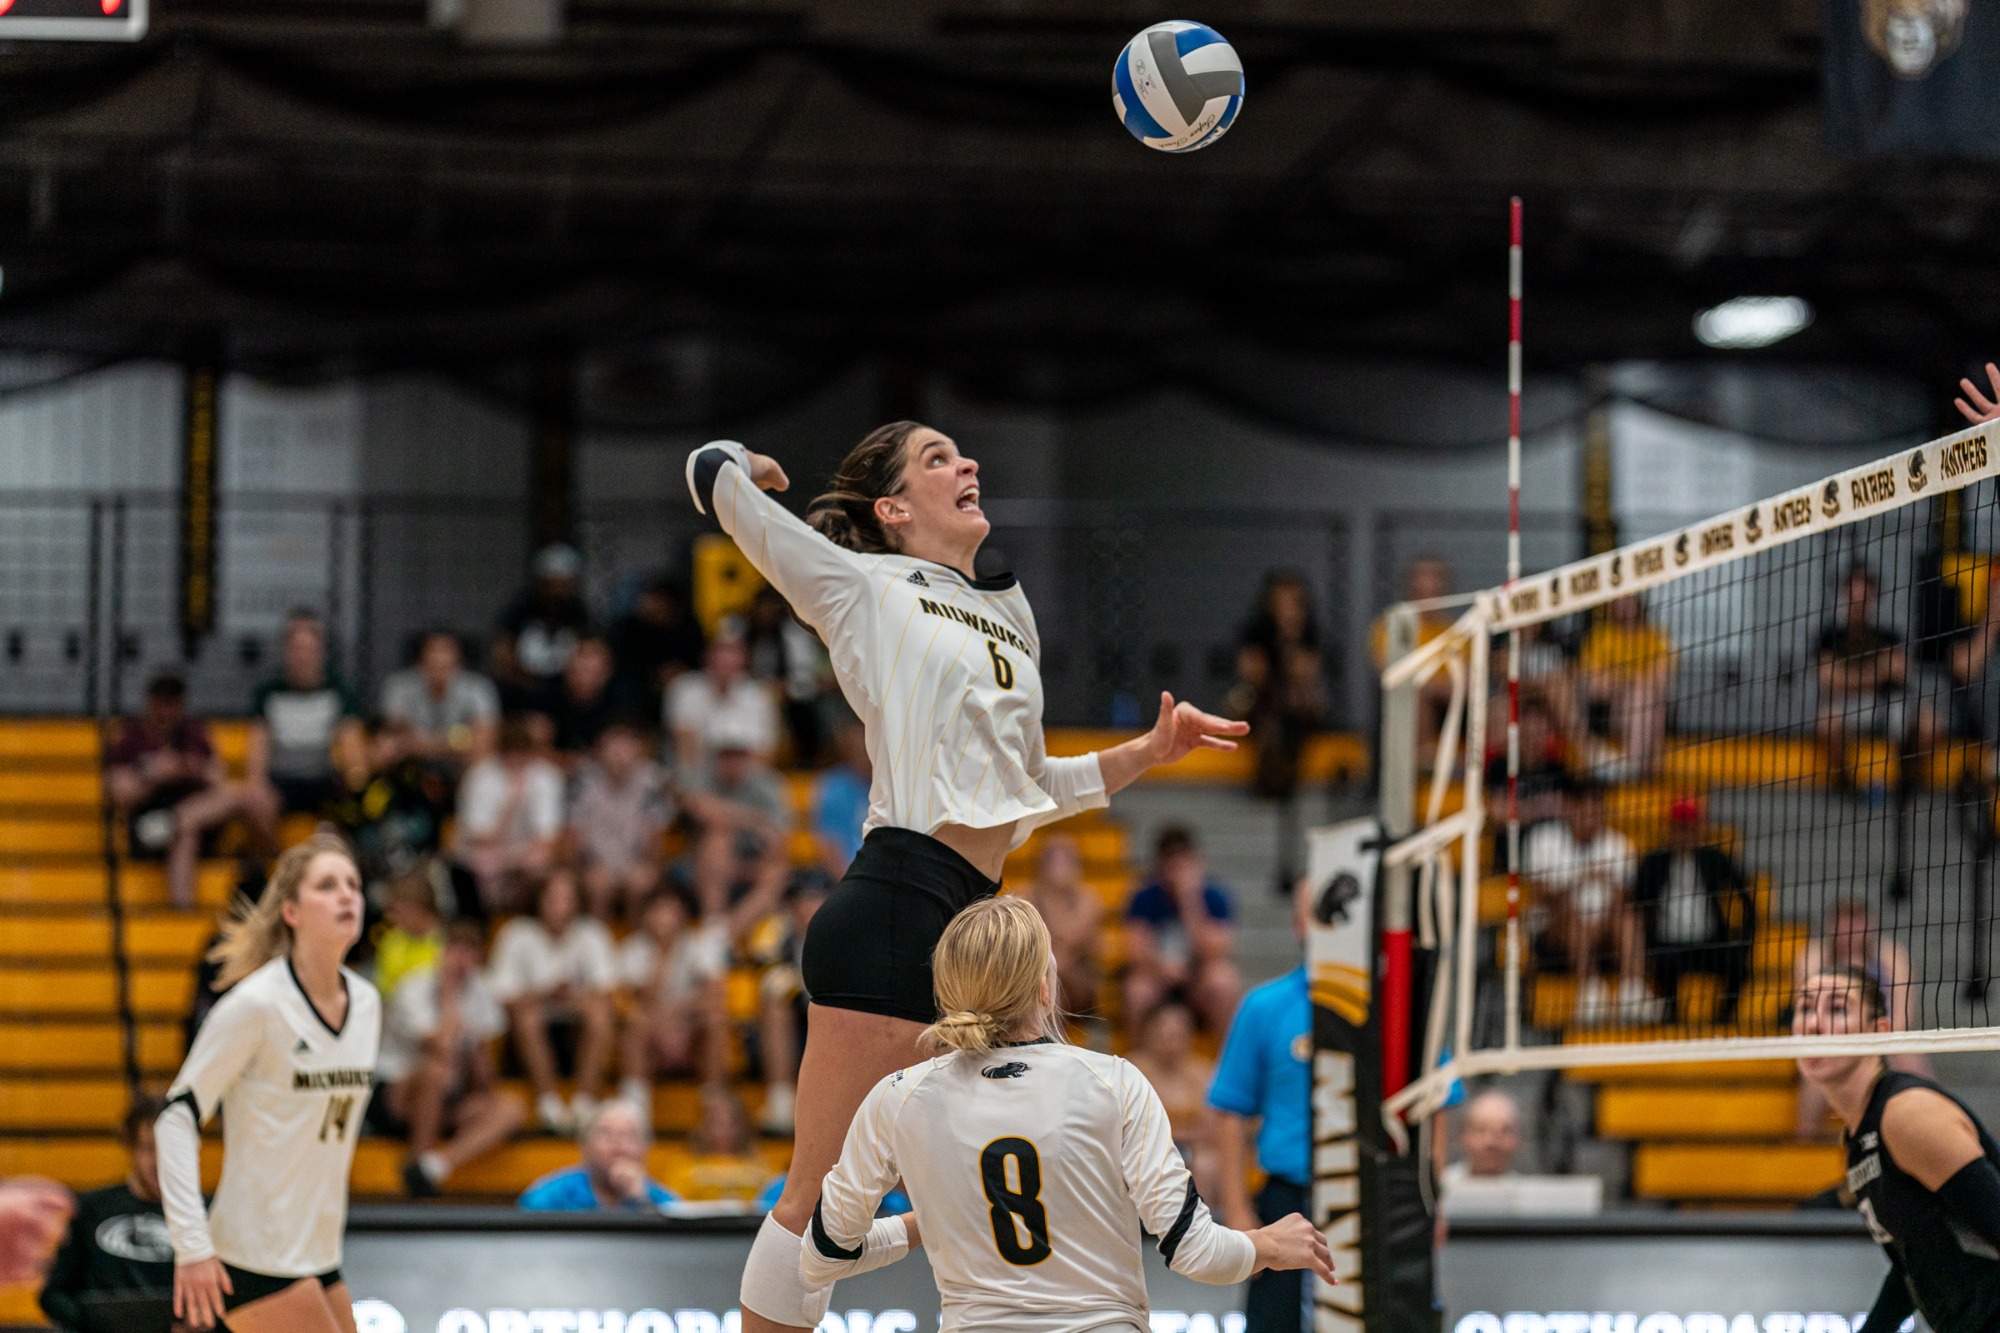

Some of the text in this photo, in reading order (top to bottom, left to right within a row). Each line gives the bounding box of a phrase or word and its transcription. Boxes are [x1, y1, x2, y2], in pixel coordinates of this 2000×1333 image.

[1940, 435, 1988, 481] PANTHERS
[986, 638, 1015, 691] 6
[318, 1093, 355, 1144] 14
[978, 1134, 1055, 1269] 8
